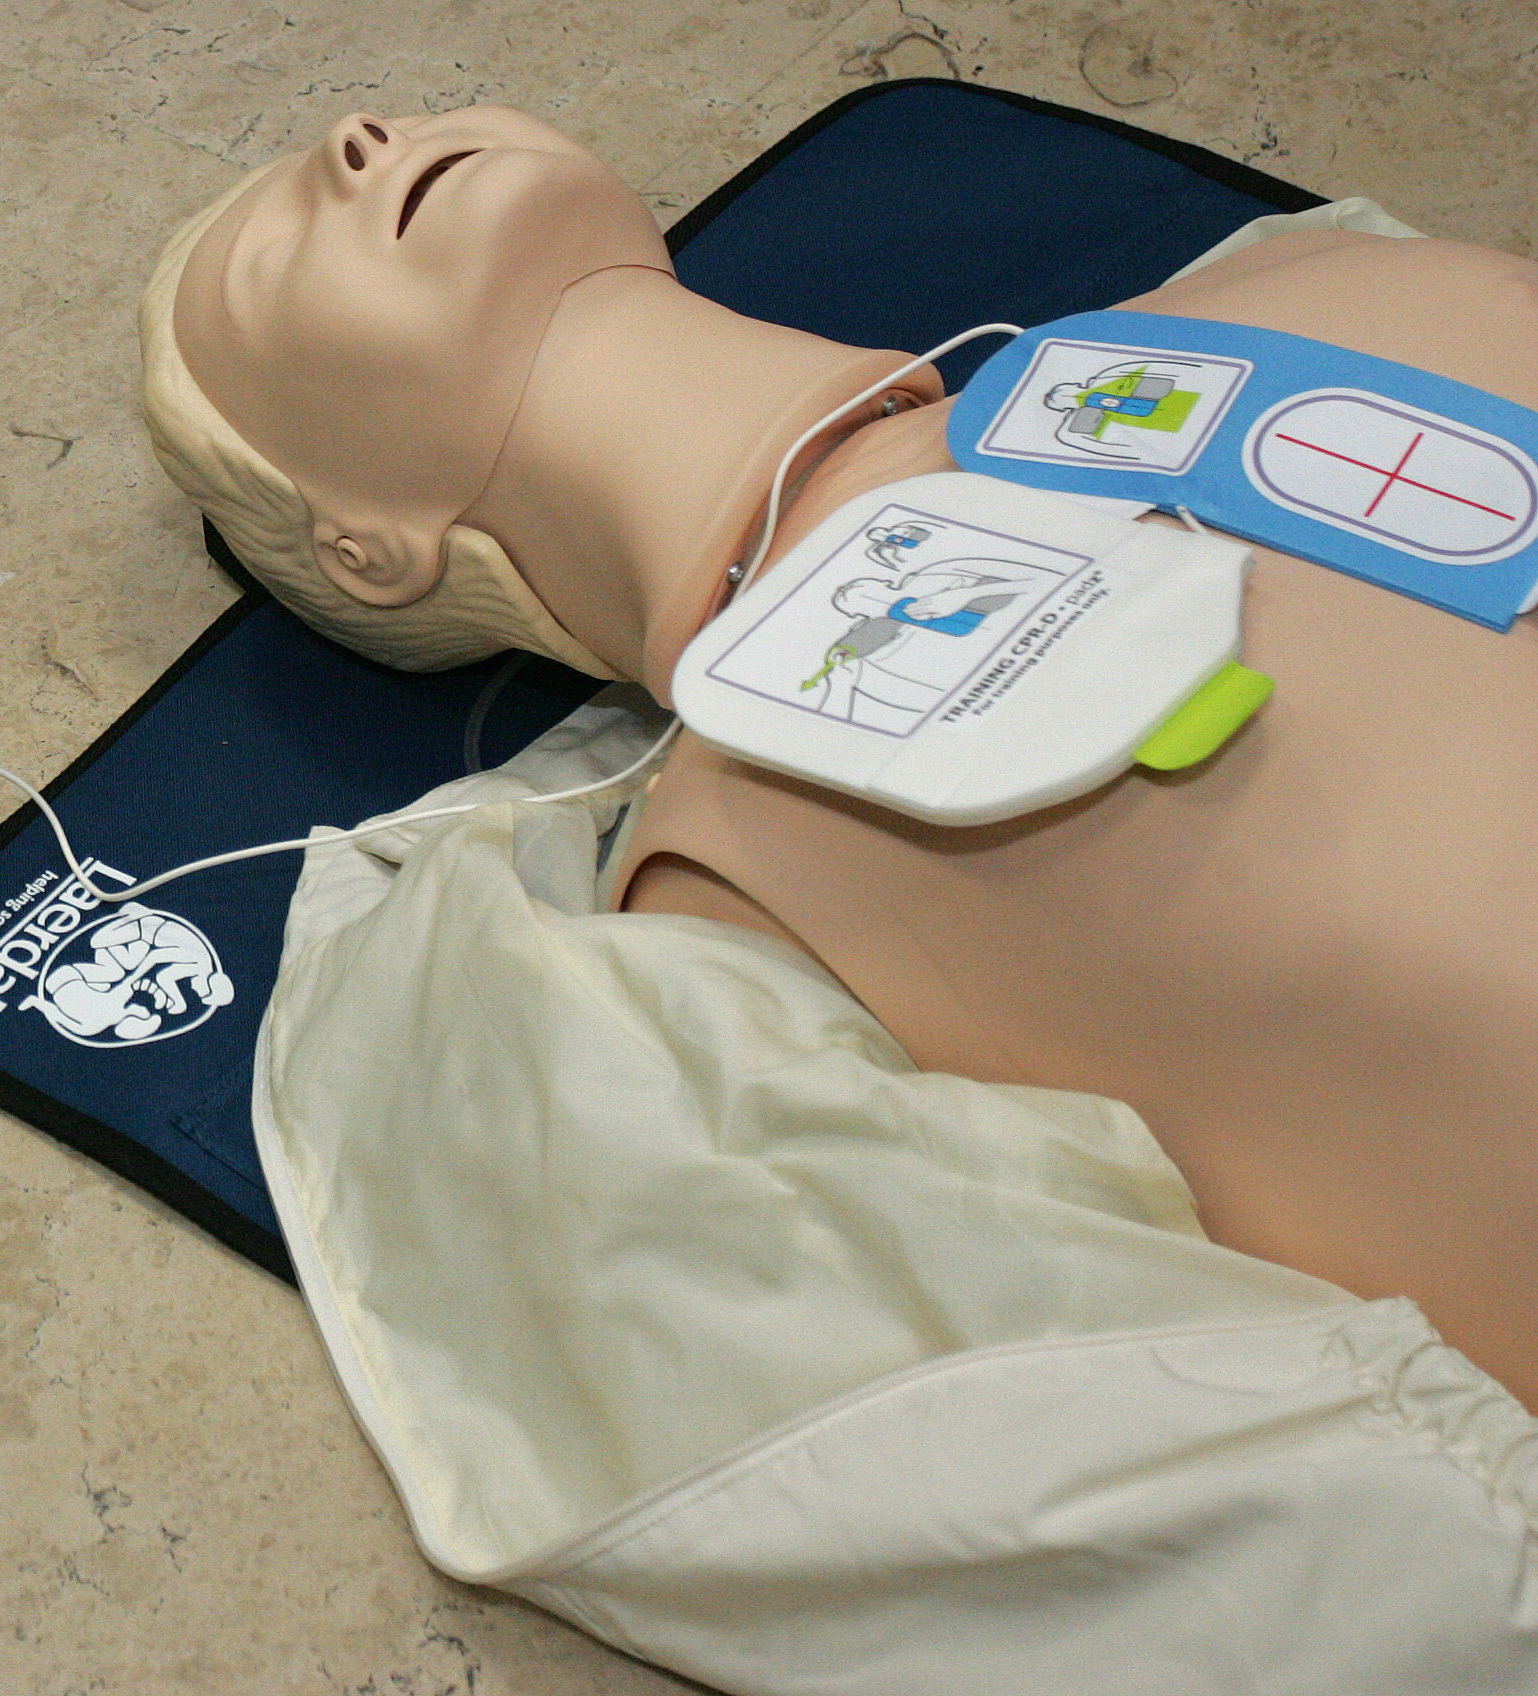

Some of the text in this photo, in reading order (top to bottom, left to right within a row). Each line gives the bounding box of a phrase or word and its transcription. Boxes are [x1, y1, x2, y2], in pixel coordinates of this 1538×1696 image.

[940, 658, 1016, 722] TRAINING
[972, 699, 995, 716] For
[991, 657, 1039, 698] training
[1034, 610, 1084, 657] purposes
[5, 870, 59, 912] helping
